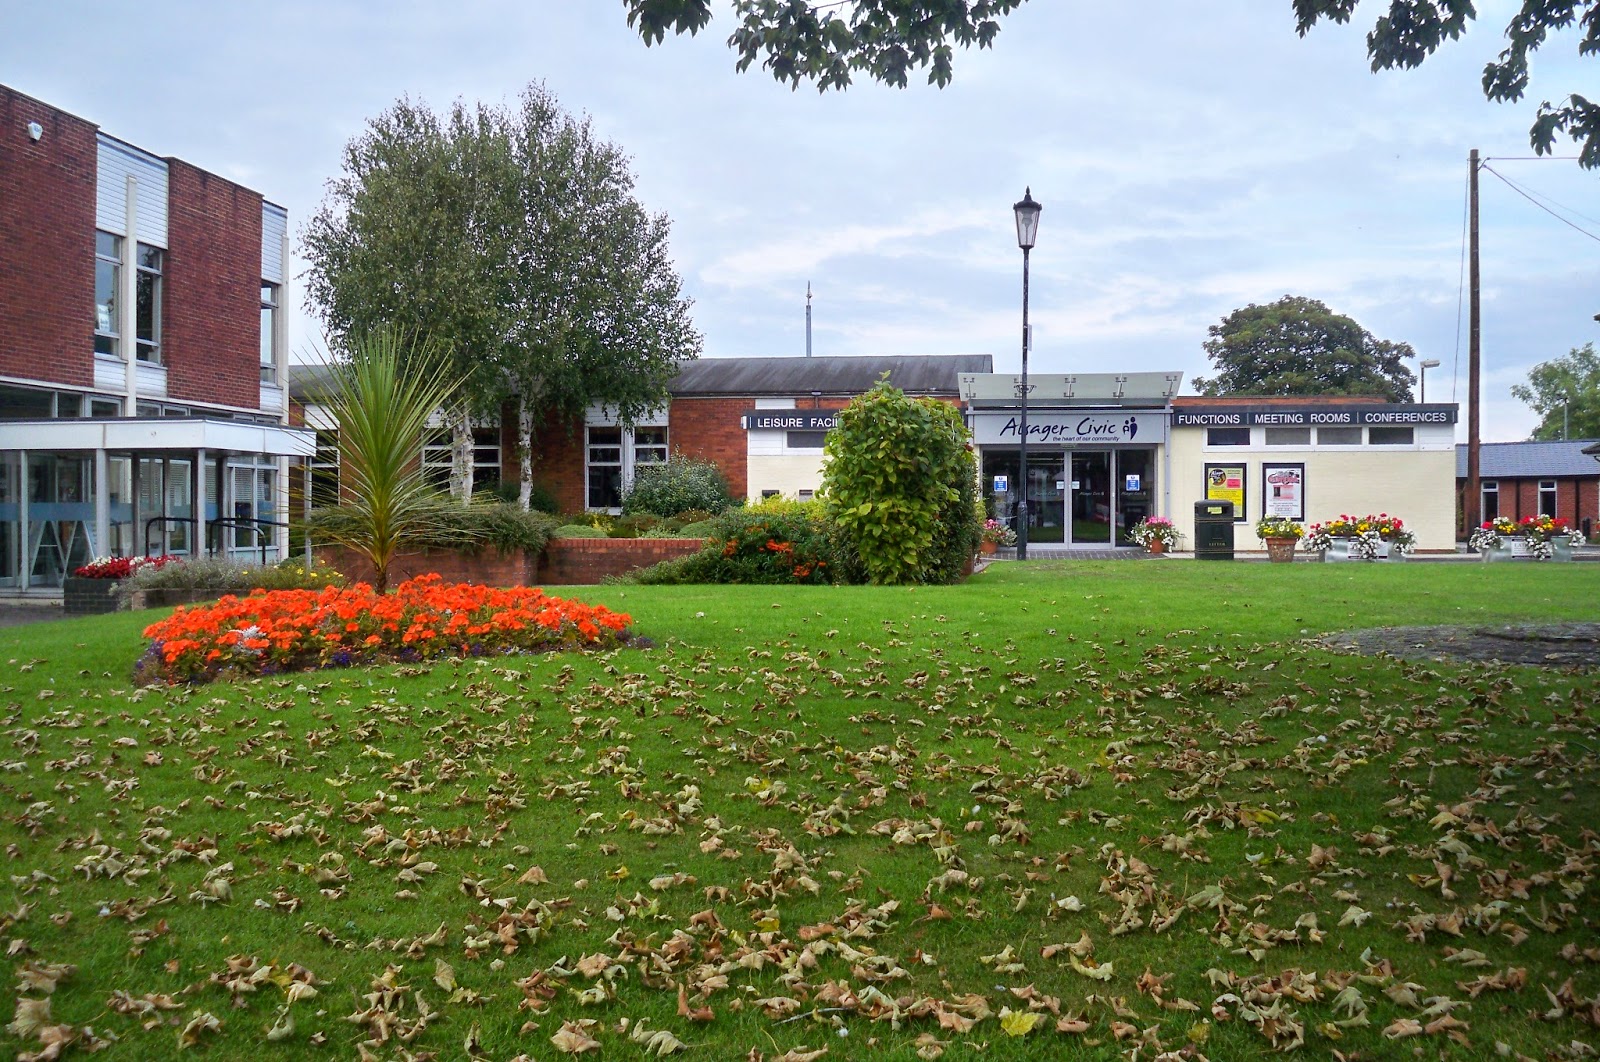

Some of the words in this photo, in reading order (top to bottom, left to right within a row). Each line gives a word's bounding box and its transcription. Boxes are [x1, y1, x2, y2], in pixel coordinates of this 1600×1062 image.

[757, 418, 803, 428] LEISURE
[1178, 414, 1241, 425] FUNCTIONS
[1254, 413, 1304, 424] MEETING
[1310, 413, 1351, 423] ROOMS
[1365, 412, 1447, 423] CONFERENCES
[1076, 417, 1117, 436] Civic
